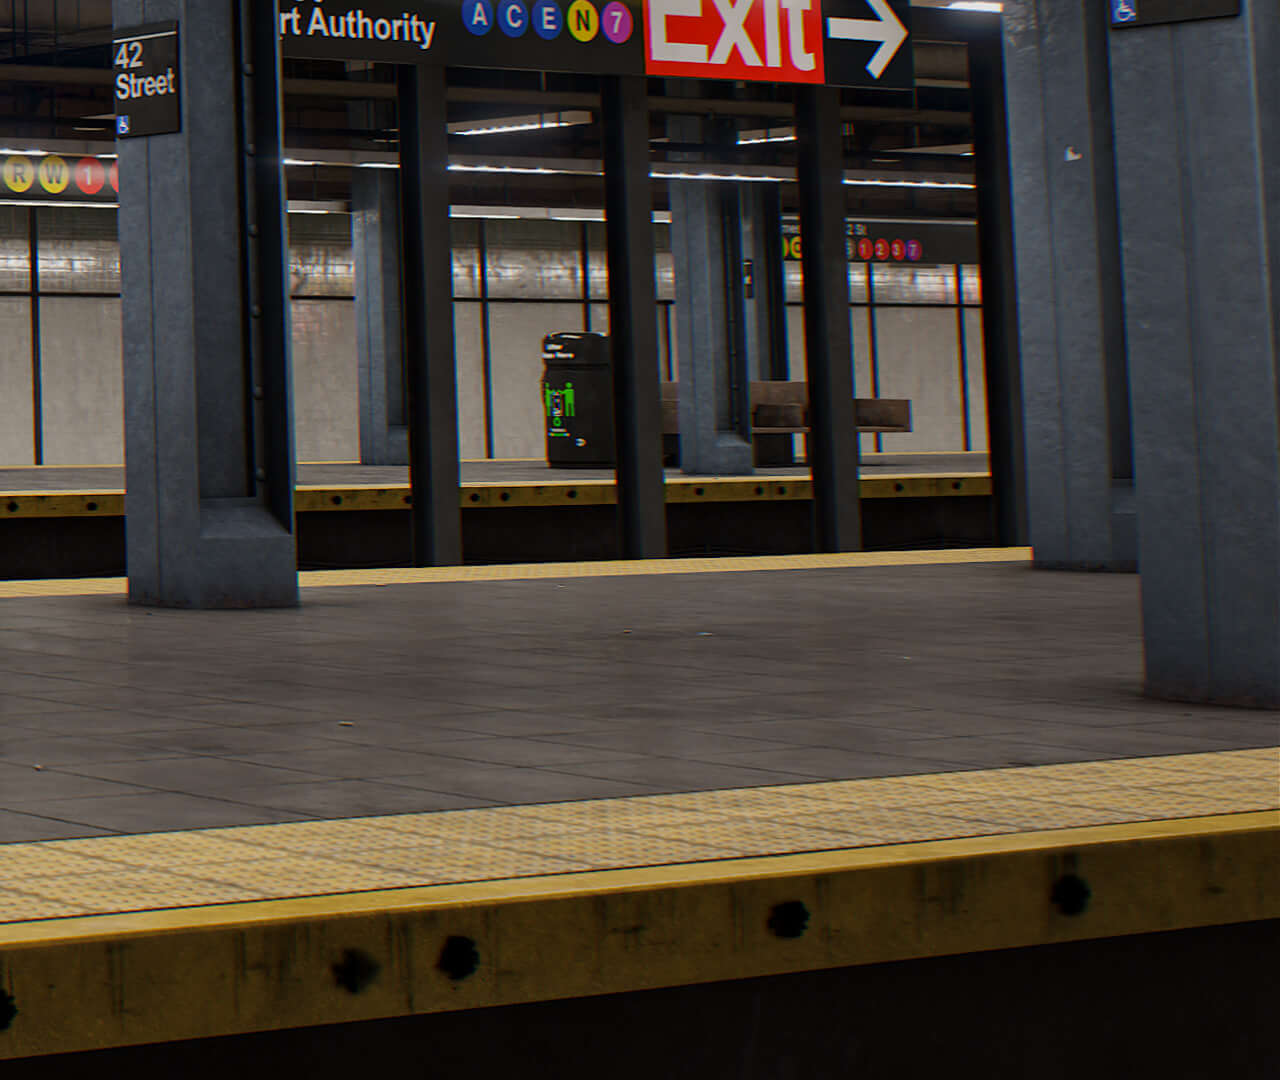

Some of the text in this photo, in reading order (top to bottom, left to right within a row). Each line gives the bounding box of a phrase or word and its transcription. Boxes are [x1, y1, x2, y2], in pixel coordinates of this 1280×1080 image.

[306, 6, 436, 50] Authority
[114, 41, 145, 69] 42
[115, 67, 177, 100] Street
